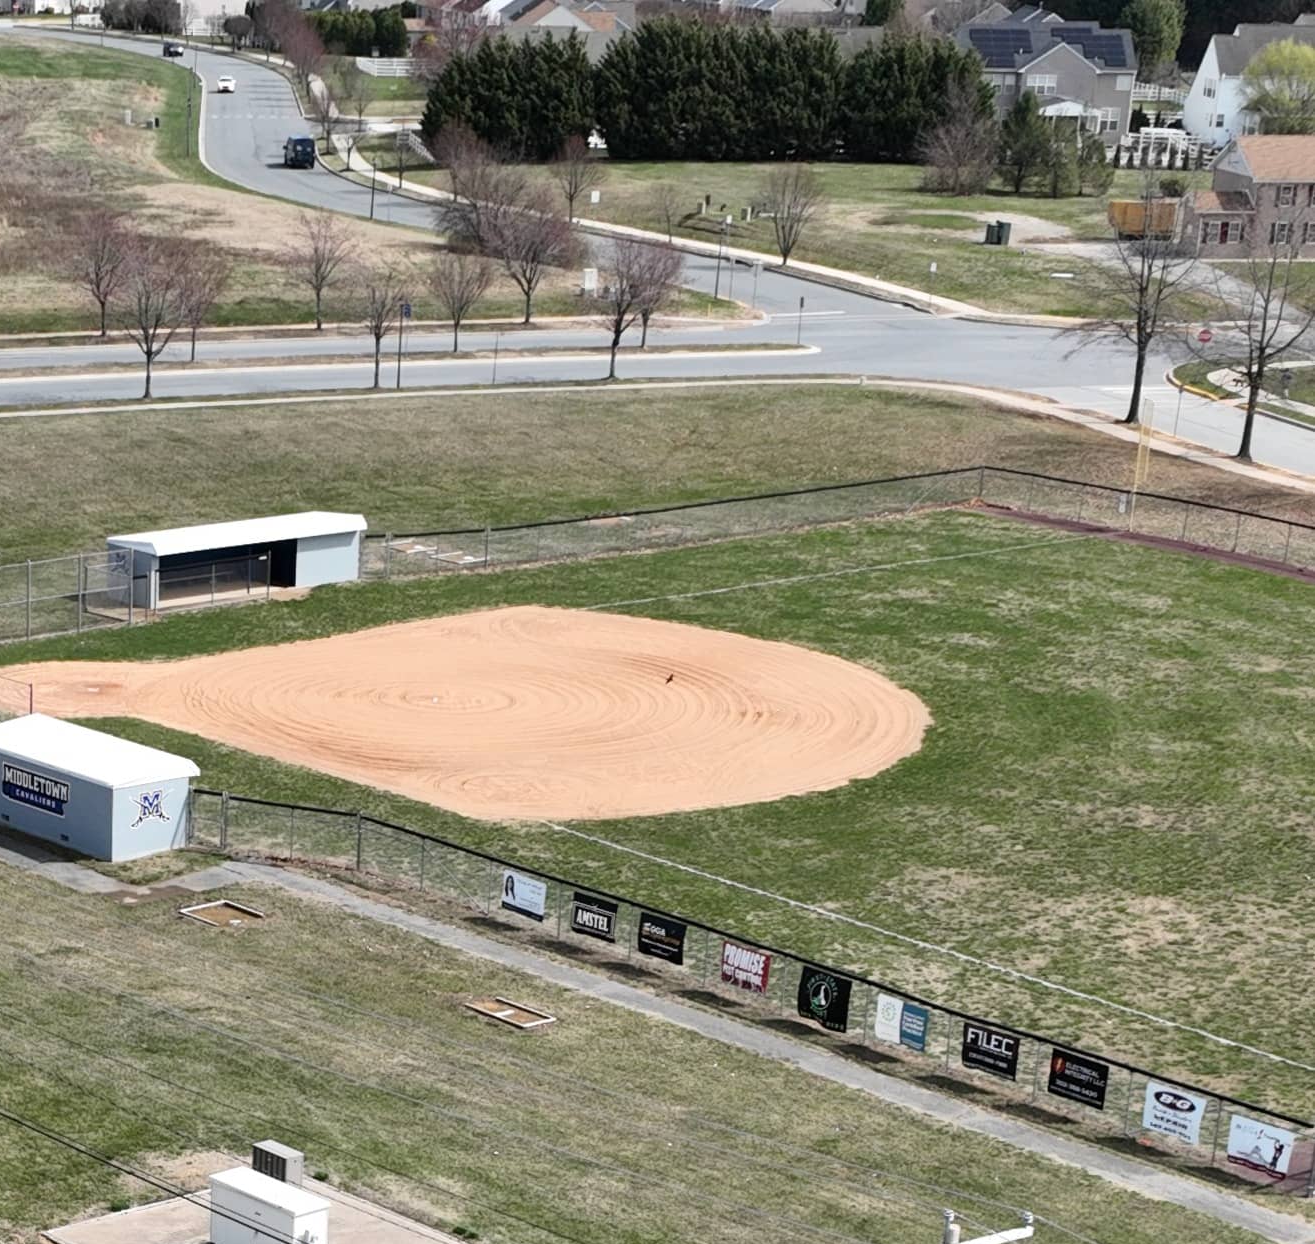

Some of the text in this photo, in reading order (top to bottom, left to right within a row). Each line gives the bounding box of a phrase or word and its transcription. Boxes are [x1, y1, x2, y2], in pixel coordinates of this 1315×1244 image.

[5, 767, 68, 802] MIDDLETOWN
[15, 787, 57, 809] CAVALIERS
[140, 791, 162, 818] M
[576, 909, 609, 932] AMSTEL
[724, 943, 766, 975] PROMISE
[1066, 1061, 1100, 1078] ELECTRICAL
